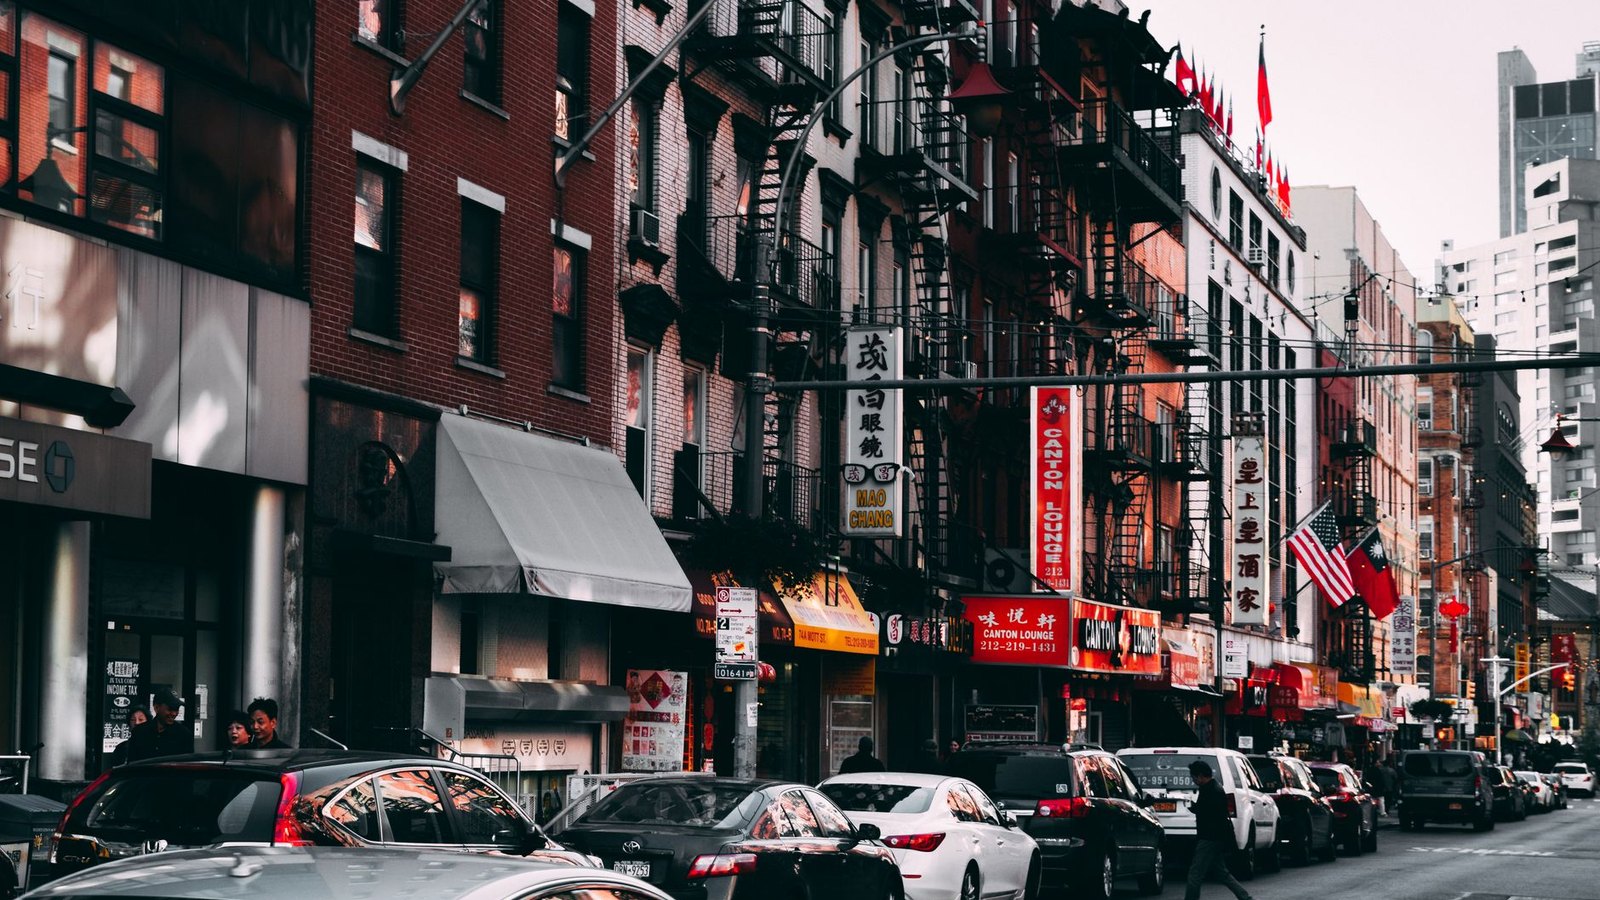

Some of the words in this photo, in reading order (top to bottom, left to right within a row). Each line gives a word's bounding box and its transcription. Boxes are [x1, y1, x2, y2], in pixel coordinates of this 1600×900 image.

[1043, 428, 1063, 490] CANTON
[856, 488, 887, 507] MAO
[849, 509, 893, 528] CHANG
[1043, 502, 1063, 563] LOUNGE
[1235, 457, 1263, 613] 皇上皇酒家
[1045, 566, 1063, 576] 212
[719, 617, 727, 629] 2
[807, 630, 819, 642] MOTT
[983, 629, 1018, 639] CANTON
[1020, 630, 1054, 640] LOUNGE
[1085, 618, 1116, 651] CANTON
[980, 641, 1056, 652] 212-219-1431
[716, 668, 745, 677] 101641
[106, 684, 126, 695] INCOME
[127, 685, 138, 695] TAX
[1137, 776, 1195, 786] 12-951-050
